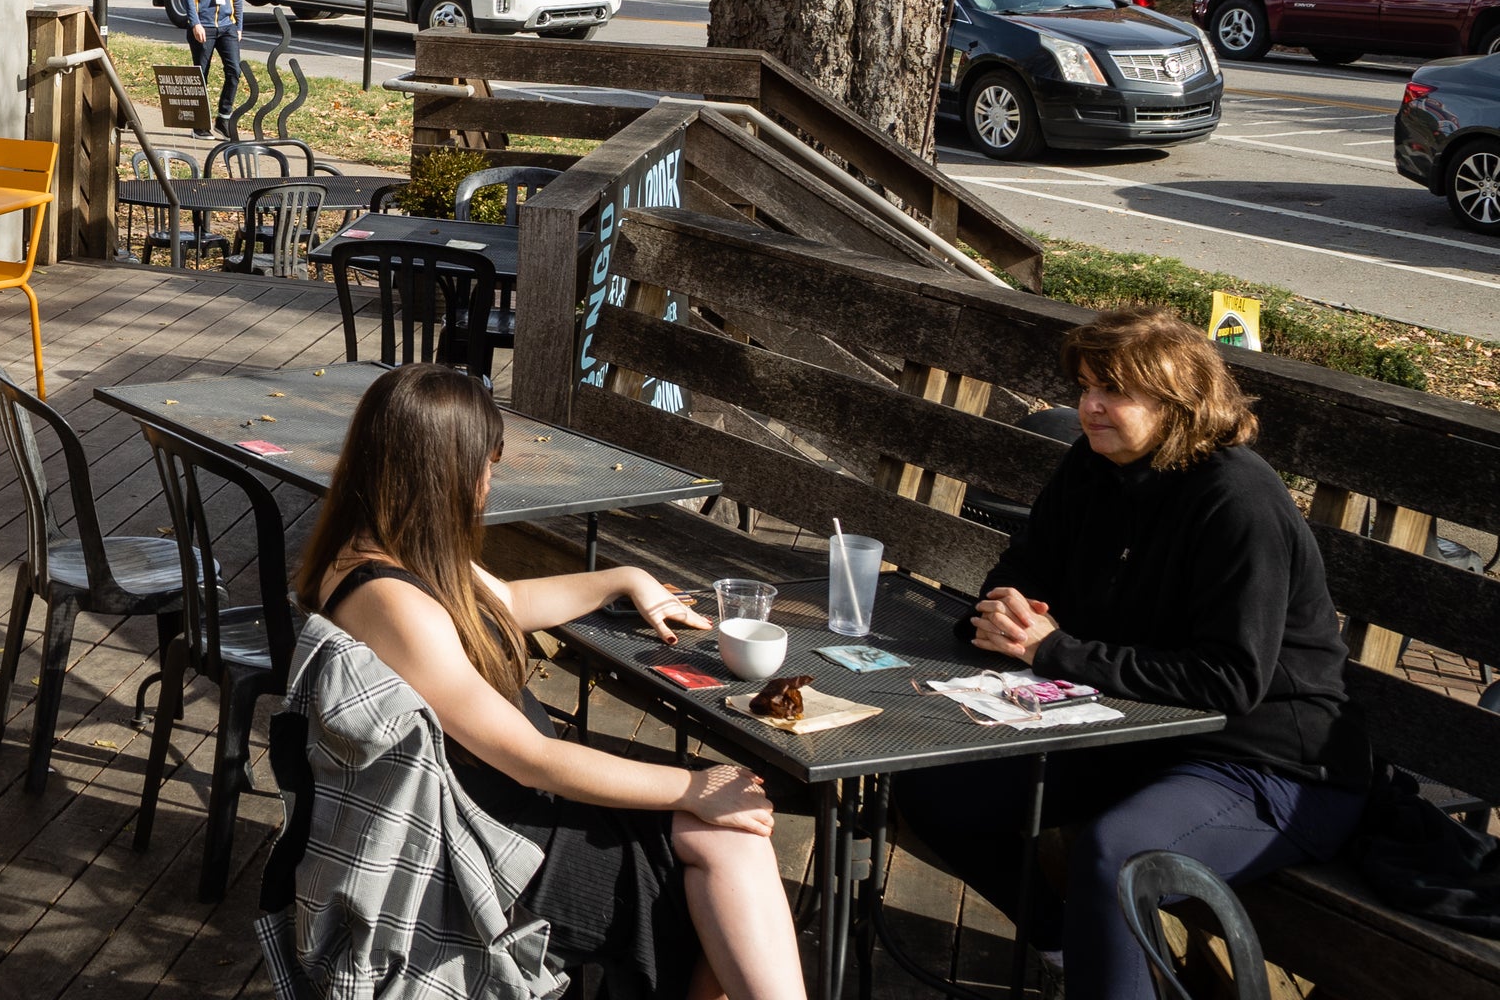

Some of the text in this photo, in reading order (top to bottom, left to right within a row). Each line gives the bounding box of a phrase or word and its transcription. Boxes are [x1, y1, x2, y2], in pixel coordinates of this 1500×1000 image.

[158, 74, 202, 85] SMALL BUSINESS
[159, 85, 206, 97] IS TOUGH ENOUGH
